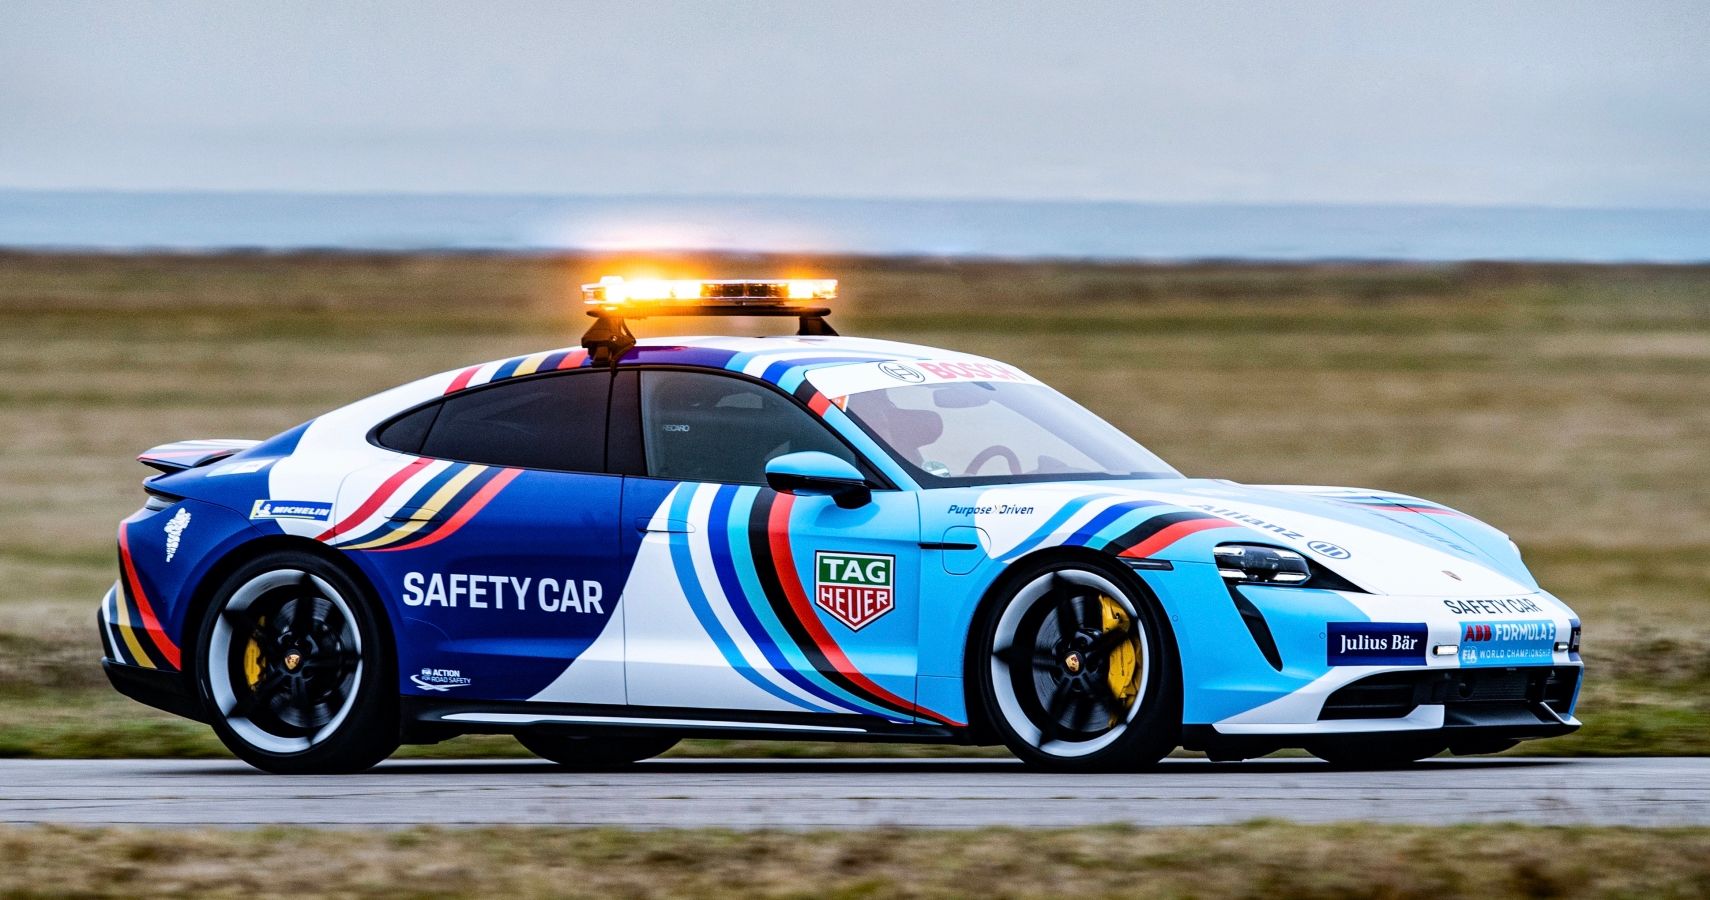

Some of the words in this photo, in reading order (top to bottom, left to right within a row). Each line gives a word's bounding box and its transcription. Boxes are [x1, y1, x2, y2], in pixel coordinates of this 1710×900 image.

[916, 362, 1026, 381] BOSCH
[272, 506, 330, 516] MICHELIN
[947, 504, 992, 517] Purpose
[999, 504, 1034, 515] Driven
[1189, 504, 1305, 539] Allianz
[822, 558, 886, 583] TAG
[402, 571, 531, 610] SAFETY
[538, 578, 604, 614] CAR
[821, 587, 888, 624] HEUER
[1443, 599, 1512, 615] SAFETY
[1506, 598, 1543, 614] CAR
[1464, 624, 1493, 642] ABB
[1494, 623, 1547, 641] FORMULA
[1547, 623, 1555, 640] E
[1340, 634, 1388, 654] Julius
[1391, 634, 1418, 650] Bär
[1480, 649, 1505, 659] WORLD
[1506, 649, 1552, 658] CHAMPIONSHIP
[432, 669, 460, 677] ACTION
